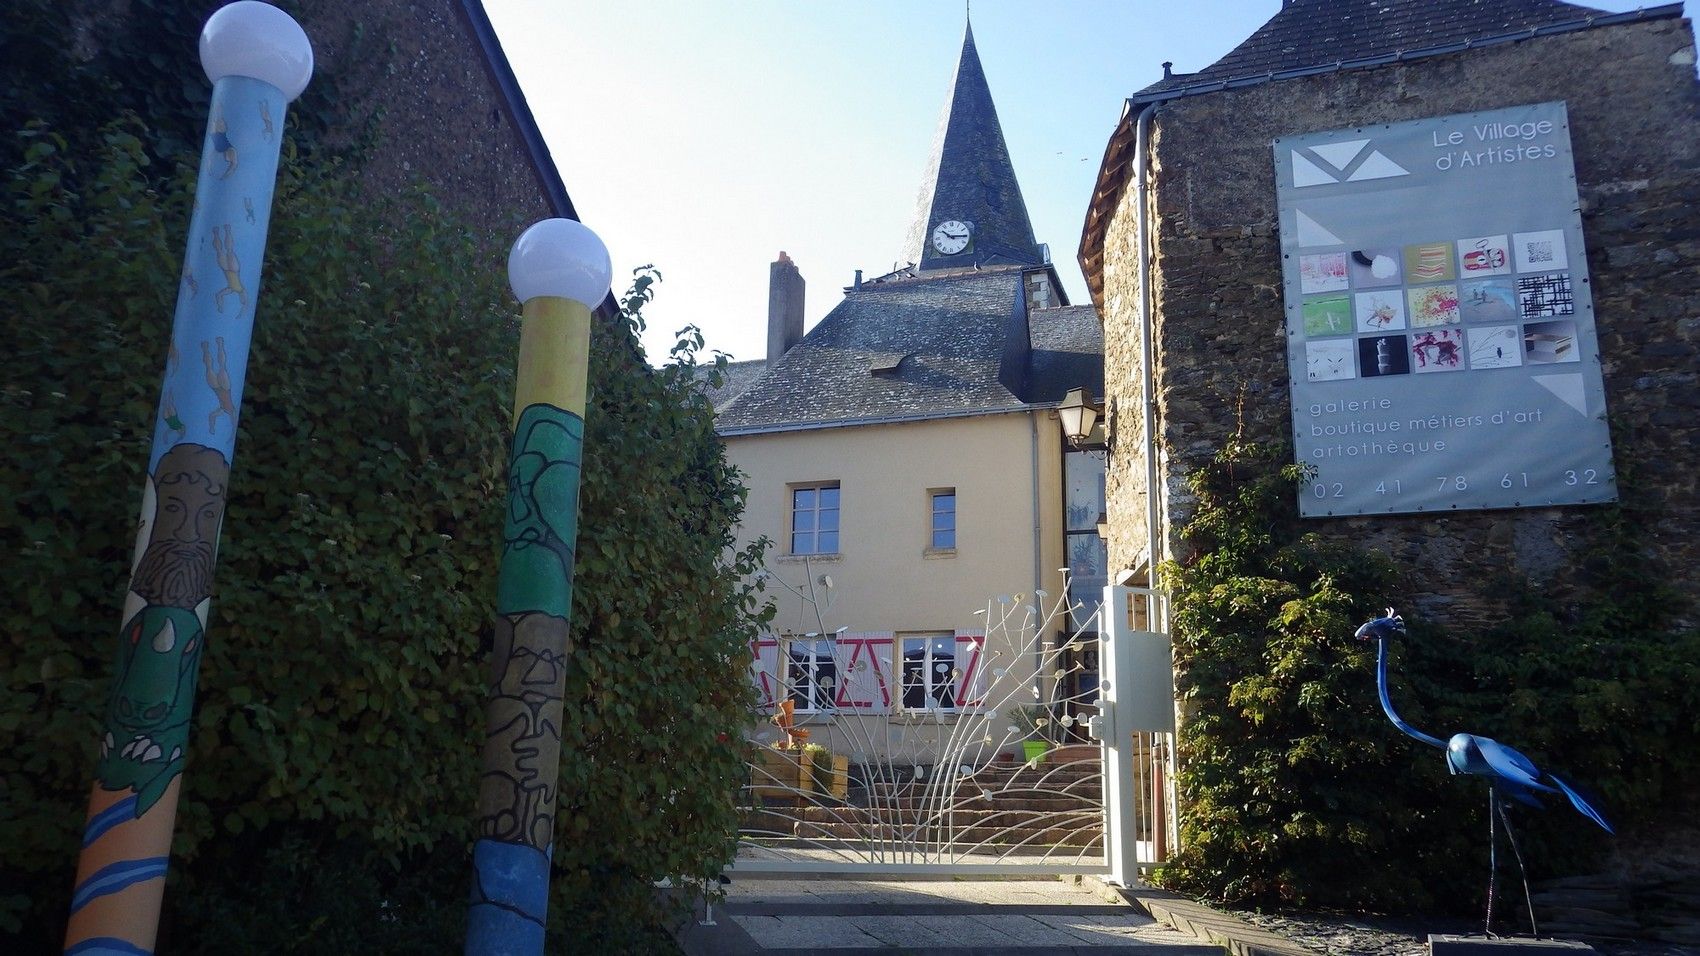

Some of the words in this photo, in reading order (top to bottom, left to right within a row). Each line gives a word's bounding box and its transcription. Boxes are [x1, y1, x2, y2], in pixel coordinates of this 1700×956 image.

[1433, 130, 1463, 147] Le
[1474, 120, 1553, 141] Village
[1436, 143, 1556, 170] d'Artistes
[1310, 397, 1392, 417] galerie
[1311, 420, 1401, 437] boutique
[1409, 413, 1483, 431] métiers
[1491, 408, 1543, 425] d'art
[1312, 439, 1446, 459] artothèque
[1314, 482, 1344, 499] 02
[1375, 479, 1401, 495] 41
[1436, 476, 1468, 493] 78
[1500, 472, 1529, 488] 61
[1565, 468, 1598, 486] 32
